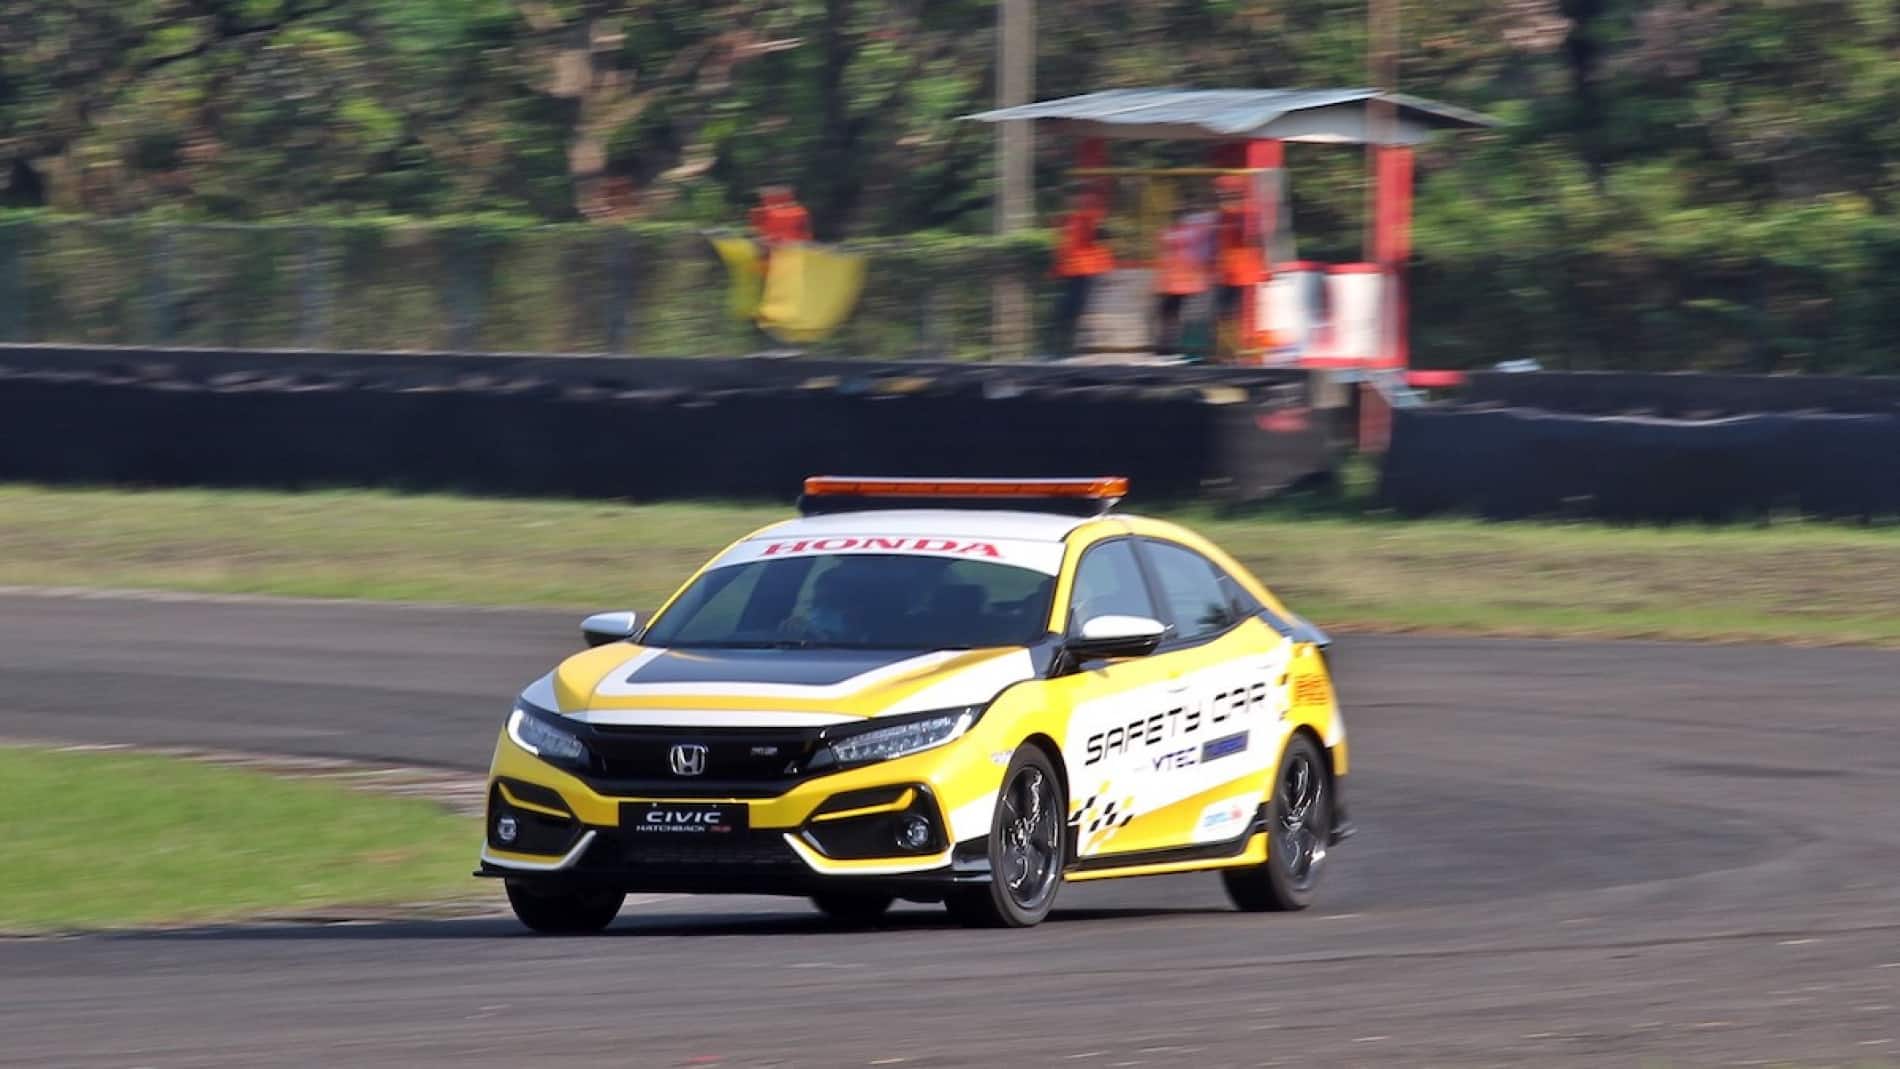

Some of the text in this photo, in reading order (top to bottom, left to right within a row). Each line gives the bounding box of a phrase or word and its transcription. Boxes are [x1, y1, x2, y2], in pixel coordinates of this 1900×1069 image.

[763, 538, 1002, 558] HONDA
[1085, 702, 1201, 766] SAFETY
[1211, 681, 1267, 724] CAR
[646, 811, 722, 824] CIVIC
